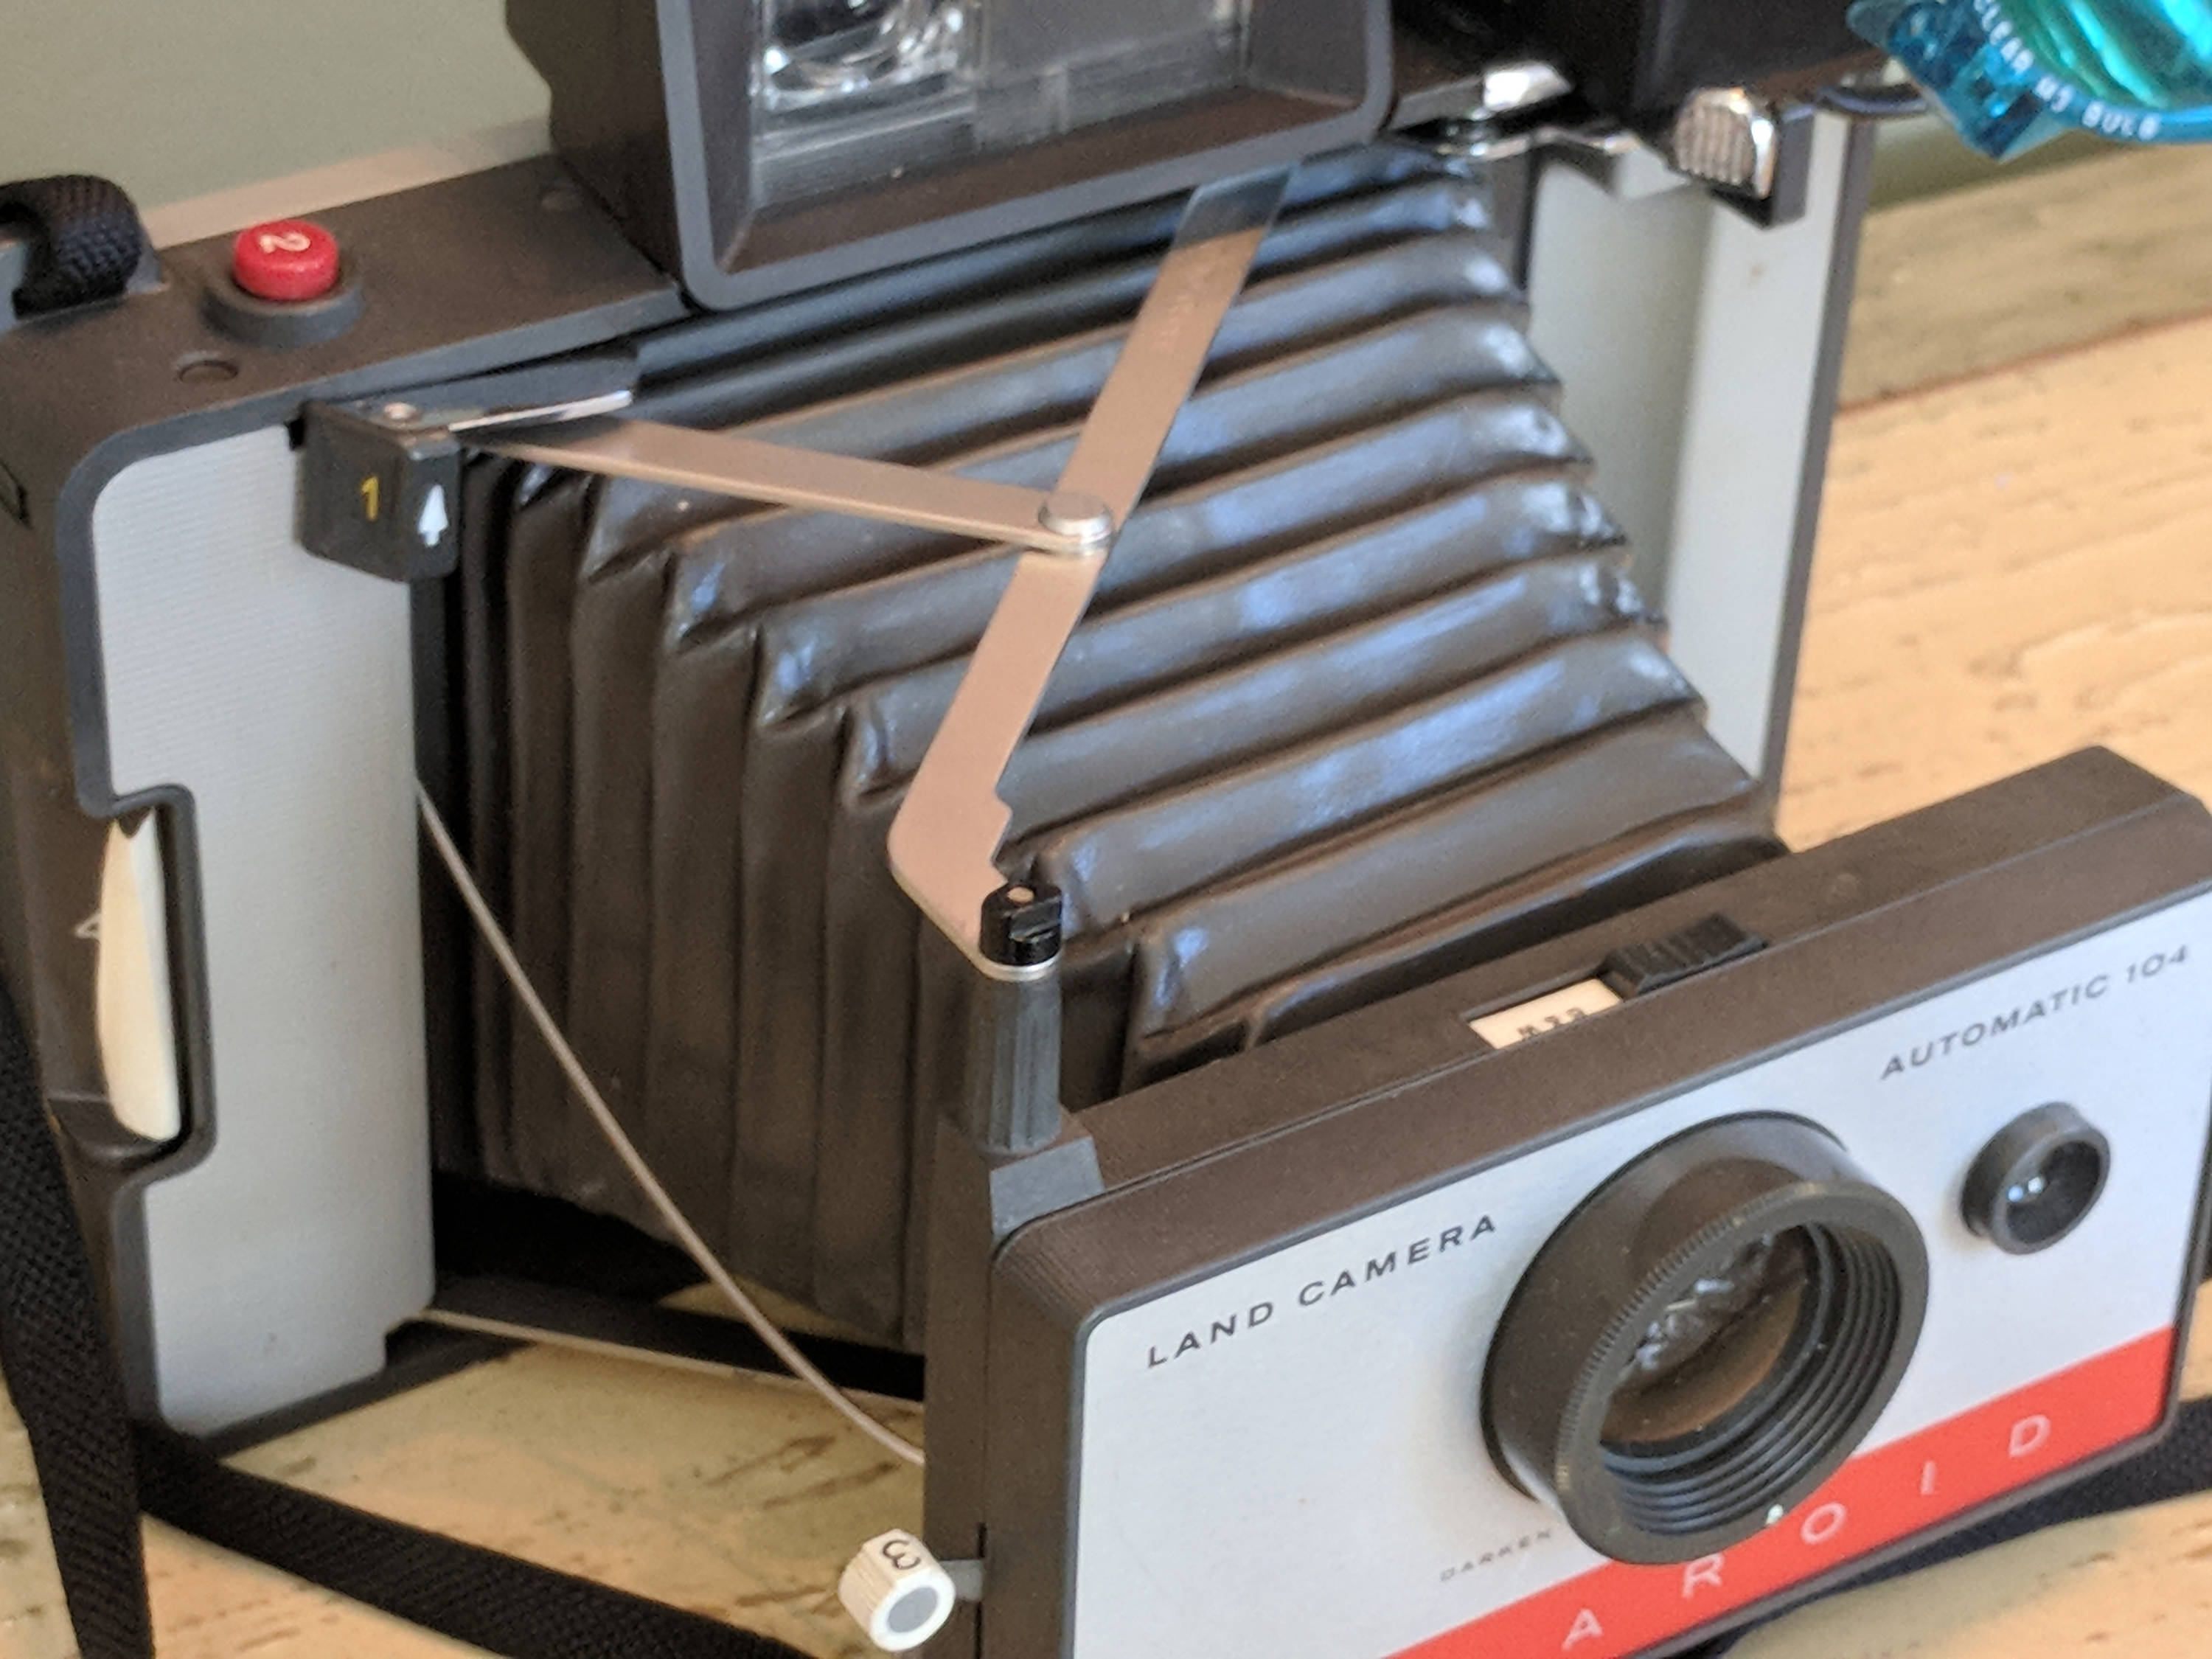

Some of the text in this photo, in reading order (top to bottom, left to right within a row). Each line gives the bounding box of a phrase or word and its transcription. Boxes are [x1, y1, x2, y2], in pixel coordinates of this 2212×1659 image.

[258, 230, 312, 254] 2
[361, 476, 380, 521] 1
[1880, 944, 2189, 1081] AUTOMATIC 104
[1147, 1214, 1497, 1368] LAND CAMERA
[882, 1538, 922, 1571] 3
